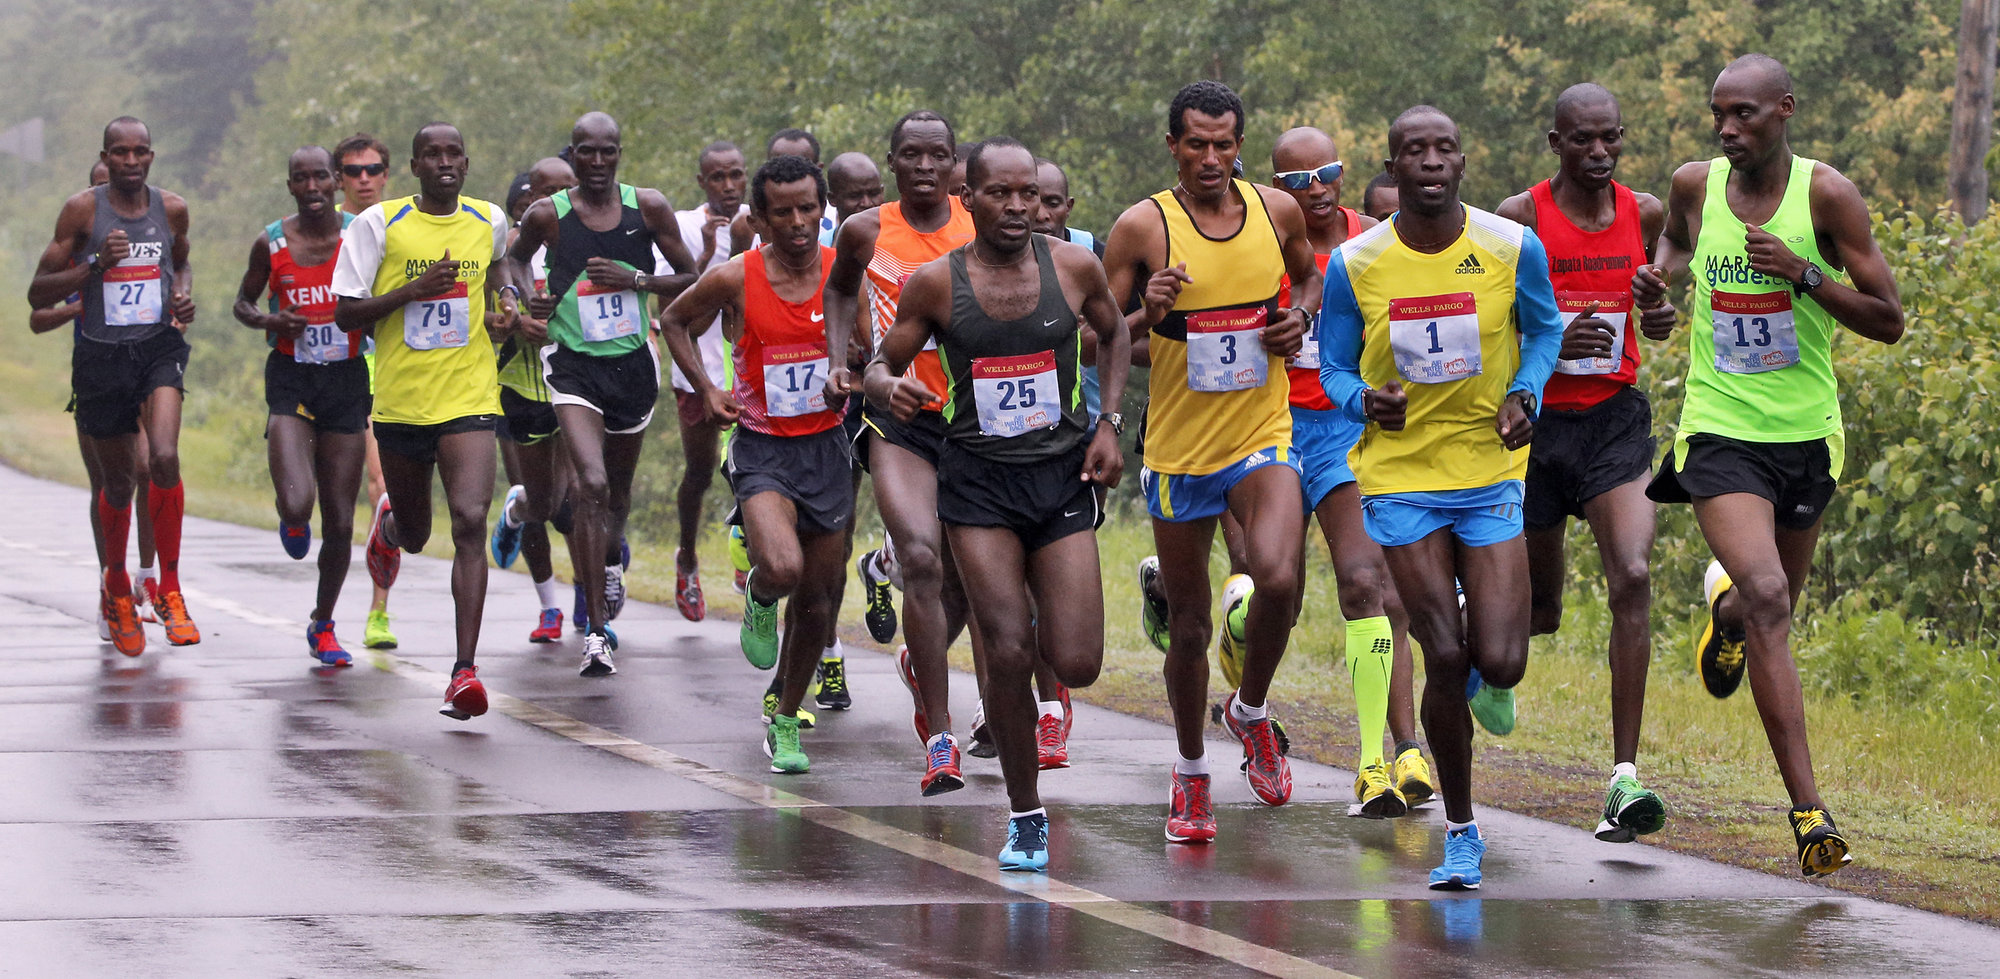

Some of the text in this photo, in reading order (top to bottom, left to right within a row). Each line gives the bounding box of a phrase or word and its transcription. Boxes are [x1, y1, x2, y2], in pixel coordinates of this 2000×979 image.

[1552, 255, 1632, 274] Zapata Roadrunners
[119, 283, 145, 306] 27
[286, 285, 340, 305] KENY
[1565, 300, 1592, 308] WELLS
[1720, 300, 1780, 309] WELLS FARGO
[421, 301, 452, 328] 79
[596, 294, 624, 319] 19
[1399, 302, 1464, 314] WELLS FARGO
[1197, 317, 1257, 328] WELLS FARGO
[1732, 316, 1772, 348] 13
[306, 325, 332, 347] 30
[1425, 321, 1444, 354] 1
[772, 352, 799, 360] WELLS
[1219, 334, 1237, 365] 3
[785, 363, 816, 393] 17
[983, 361, 1045, 373] WELLS FARGO
[996, 378, 1037, 411] 25
